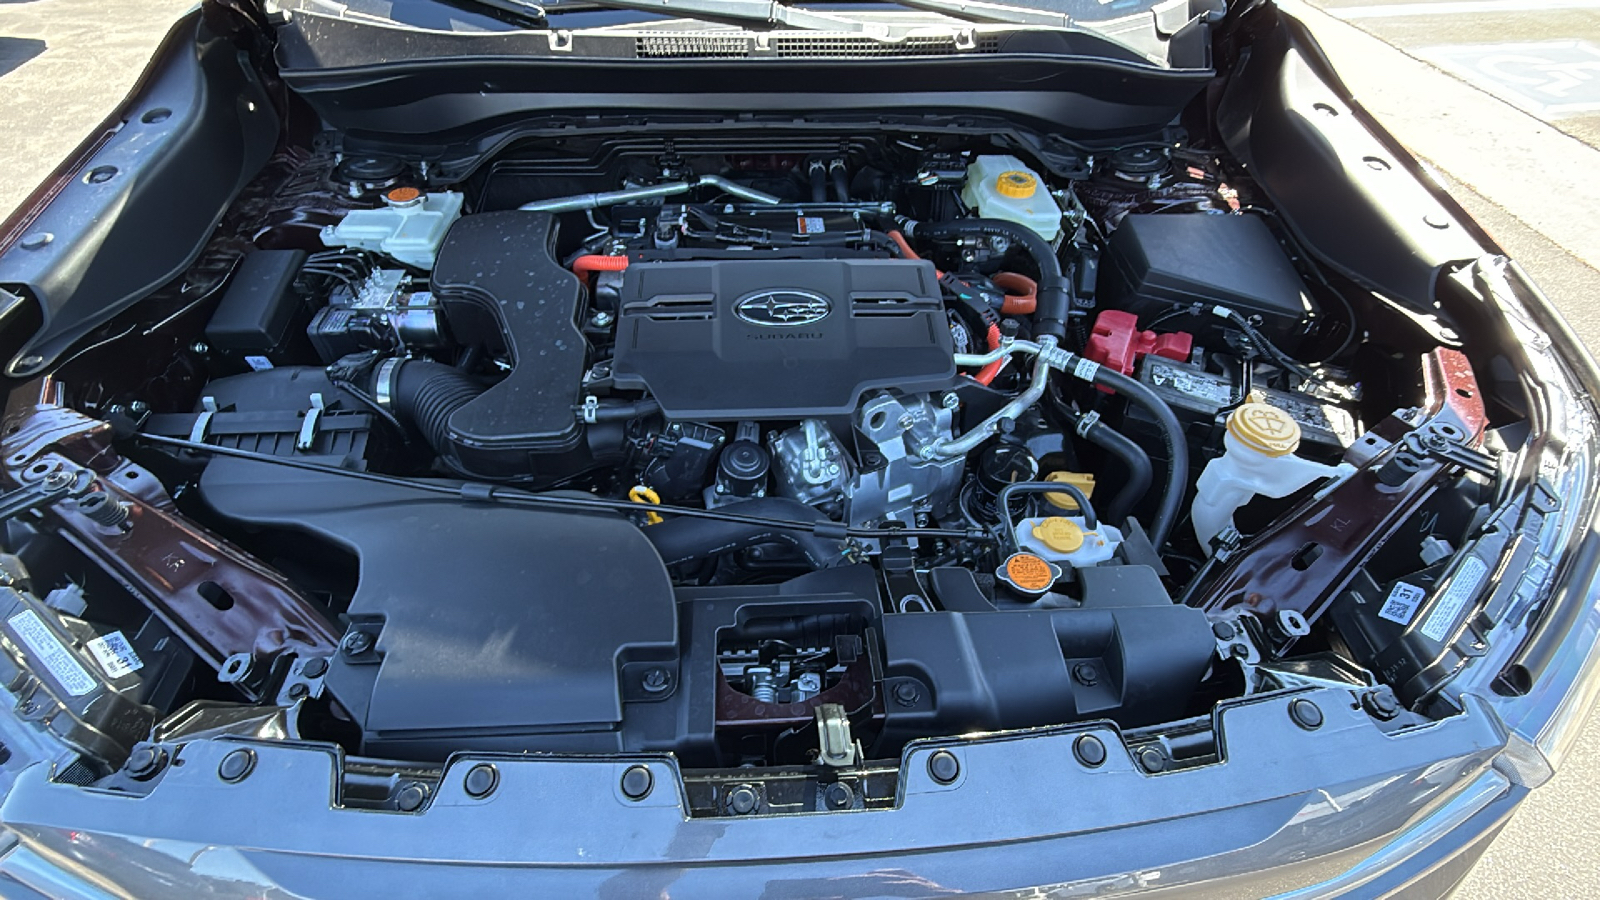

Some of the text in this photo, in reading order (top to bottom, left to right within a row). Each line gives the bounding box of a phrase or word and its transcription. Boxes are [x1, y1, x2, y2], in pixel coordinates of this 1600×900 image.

[746, 332, 823, 340] SUBARU
[1329, 517, 1351, 533] KL
[1399, 587, 1413, 600] 31
